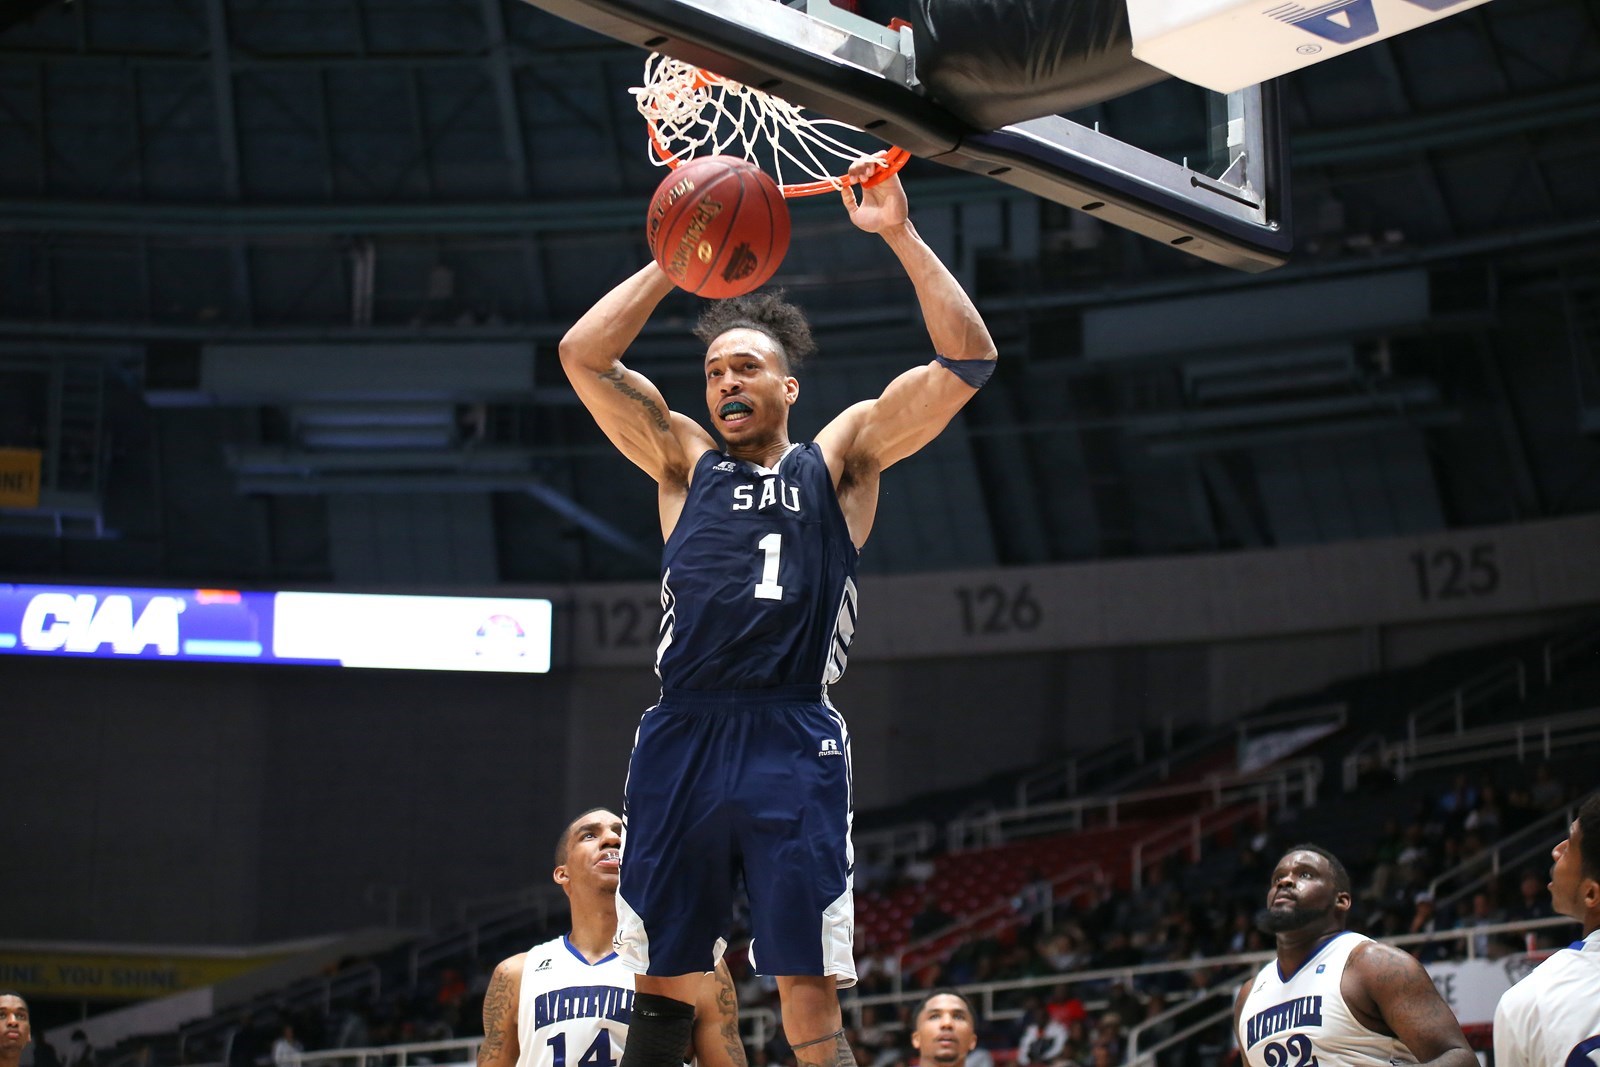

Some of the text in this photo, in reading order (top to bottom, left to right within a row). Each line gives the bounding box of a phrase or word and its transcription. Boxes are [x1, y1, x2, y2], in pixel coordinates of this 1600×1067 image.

[732, 477, 801, 512] SAU
[754, 533, 783, 601] 1
[1409, 543, 1500, 601] 125
[20, 592, 180, 656] CIAA
[954, 582, 1043, 637] 126
[546, 1027, 617, 1067] 14
